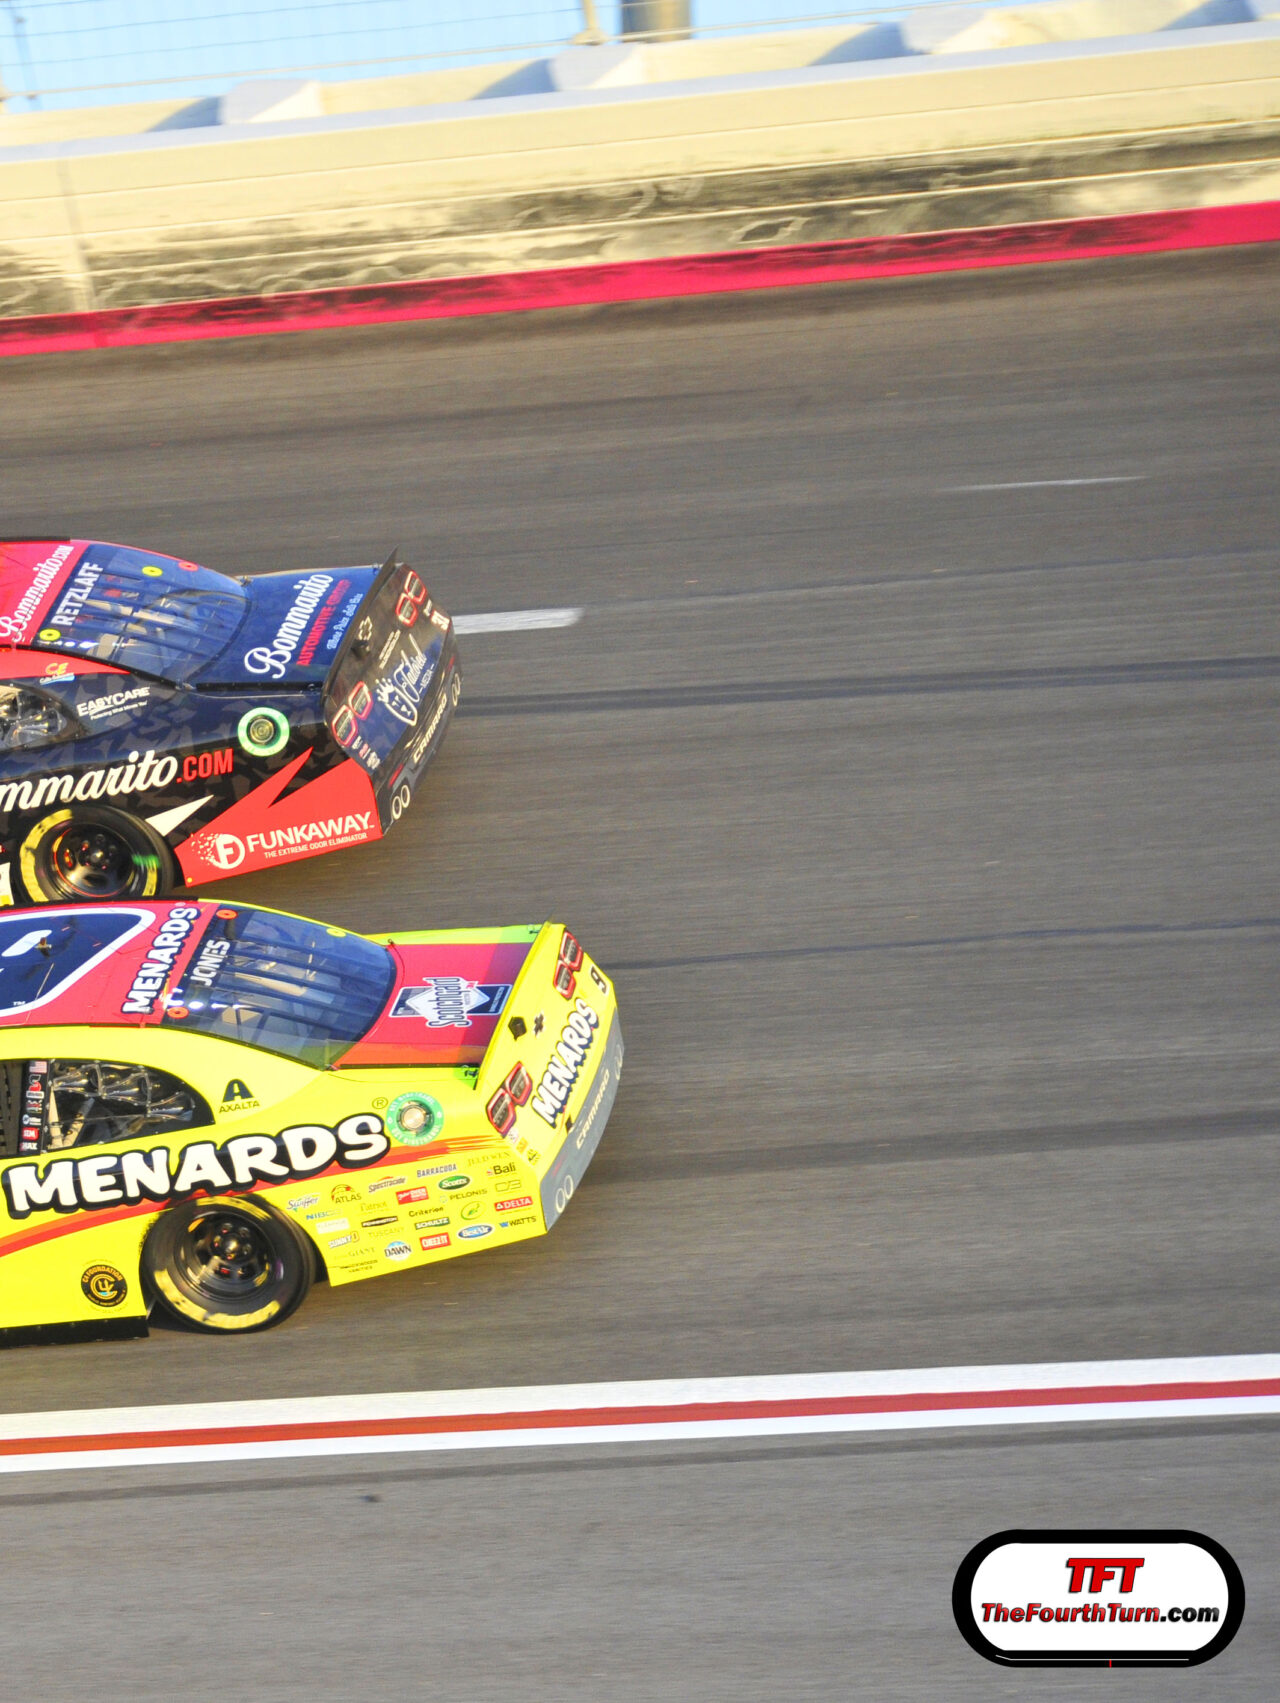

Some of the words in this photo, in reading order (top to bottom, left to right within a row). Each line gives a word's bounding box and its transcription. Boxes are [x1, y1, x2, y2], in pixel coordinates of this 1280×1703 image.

[51, 562, 103, 626] RETZLAFF
[244, 574, 333, 679] Bommarito
[296, 605, 336, 667] AUTOMOTIVE
[413, 692, 448, 764] CAMARO
[246, 811, 372, 853] FUNKAWAY
[264, 851, 277, 859] THE
[278, 845, 309, 857] EXTREME
[309, 840, 328, 850] ODOR
[329, 832, 368, 847] ELIMINATOR
[121, 907, 200, 1015] MENARDS
[189, 939, 231, 987] JONES
[590, 966, 608, 995] 9
[424, 977, 472, 1028] Scotchgard
[532, 997, 600, 1127] MENARDS
[219, 1101, 260, 1114] AXALTA
[576, 1069, 610, 1149] CAMARO
[3, 1113, 390, 1216] MENARDS
[416, 1163, 457, 1178] BARRACUDA
[493, 1161, 516, 1175] Bali
[287, 1195, 319, 1210] Swiffer
[335, 1193, 362, 1204] ATLAS
[449, 1188, 488, 1201] PELONIS
[503, 1197, 532, 1209] DELTA
[408, 1206, 444, 1217] Criterion
[508, 1216, 537, 1227] WATTS
[384, 1244, 412, 1258] DAWN
